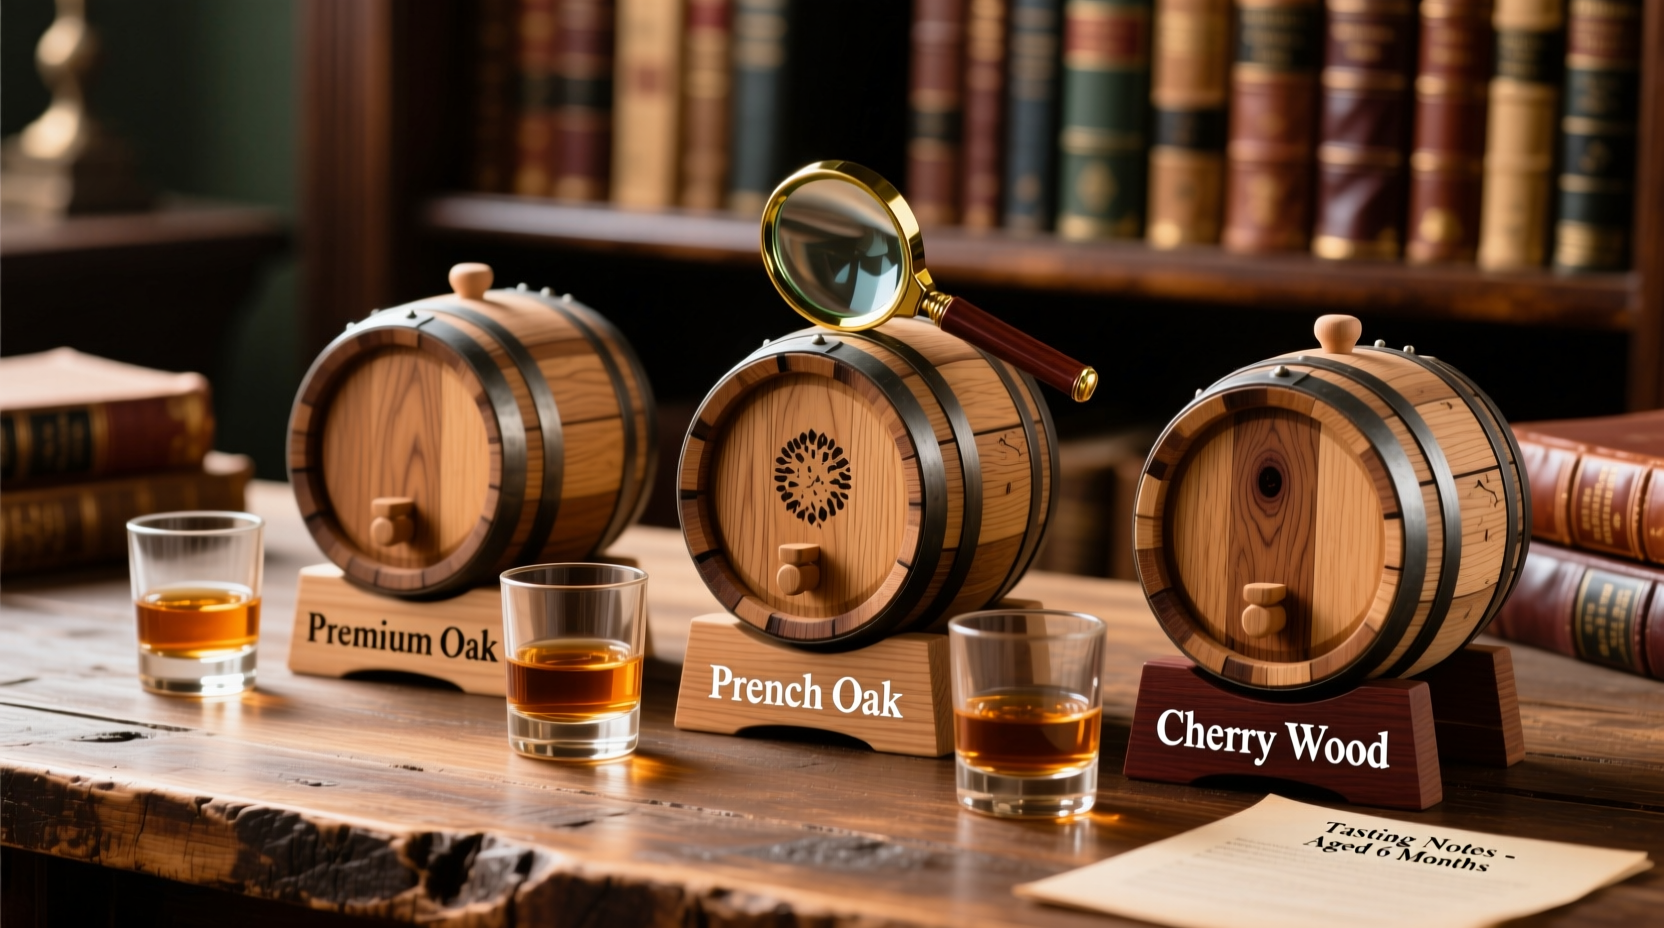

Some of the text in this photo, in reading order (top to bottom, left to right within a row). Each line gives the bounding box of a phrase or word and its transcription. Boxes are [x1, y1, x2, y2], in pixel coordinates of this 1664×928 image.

[307, 612, 498, 662] Premium Oak
[708, 664, 903, 719] Prench Oak
[1157, 709, 1390, 770] Cherry Wood
[1302, 835, 1373, 856] Aged
[1376, 846, 1392, 858] 6
[1396, 847, 1490, 873] Months
[1325, 821, 1416, 848] Tasting
[1423, 836, 1498, 858] Notes
